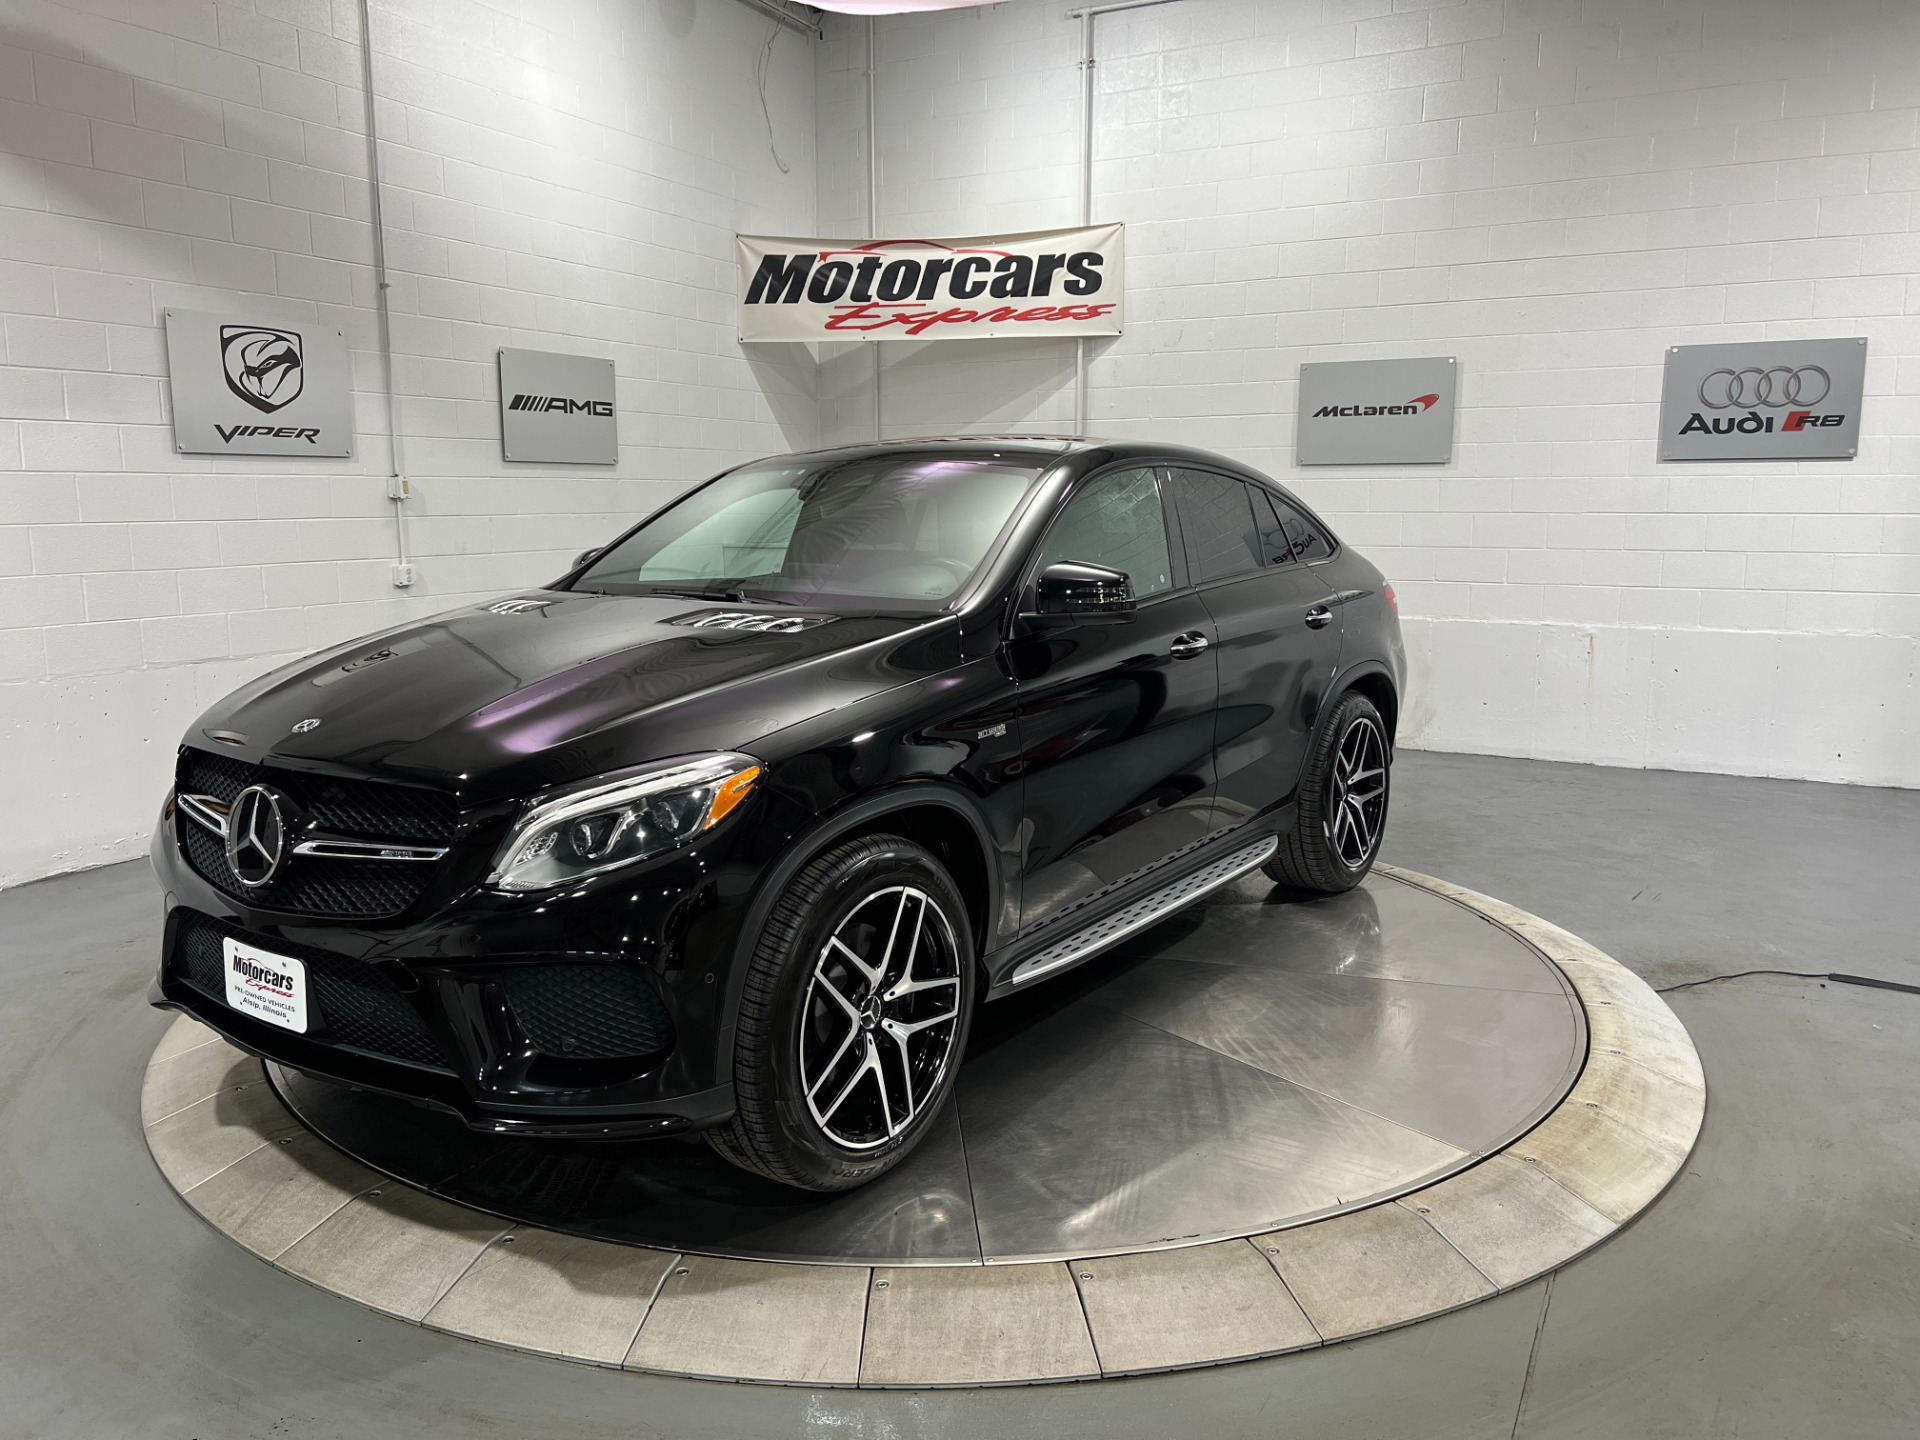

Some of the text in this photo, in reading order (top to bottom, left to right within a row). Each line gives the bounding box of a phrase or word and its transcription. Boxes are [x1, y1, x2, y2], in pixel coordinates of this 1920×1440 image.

[743, 252, 1104, 304] Motorcars
[823, 302, 1117, 335] Express
[1312, 404, 1418, 418] McLaren
[1677, 411, 1846, 435] Audi R8
[213, 424, 321, 444] VIPER
[233, 954, 294, 991] Motorcars
[234, 985, 296, 1013] PRE-OWNED VEHICLES
[245, 978, 295, 998] Express
[262, 1004, 287, 1018] Illinois
